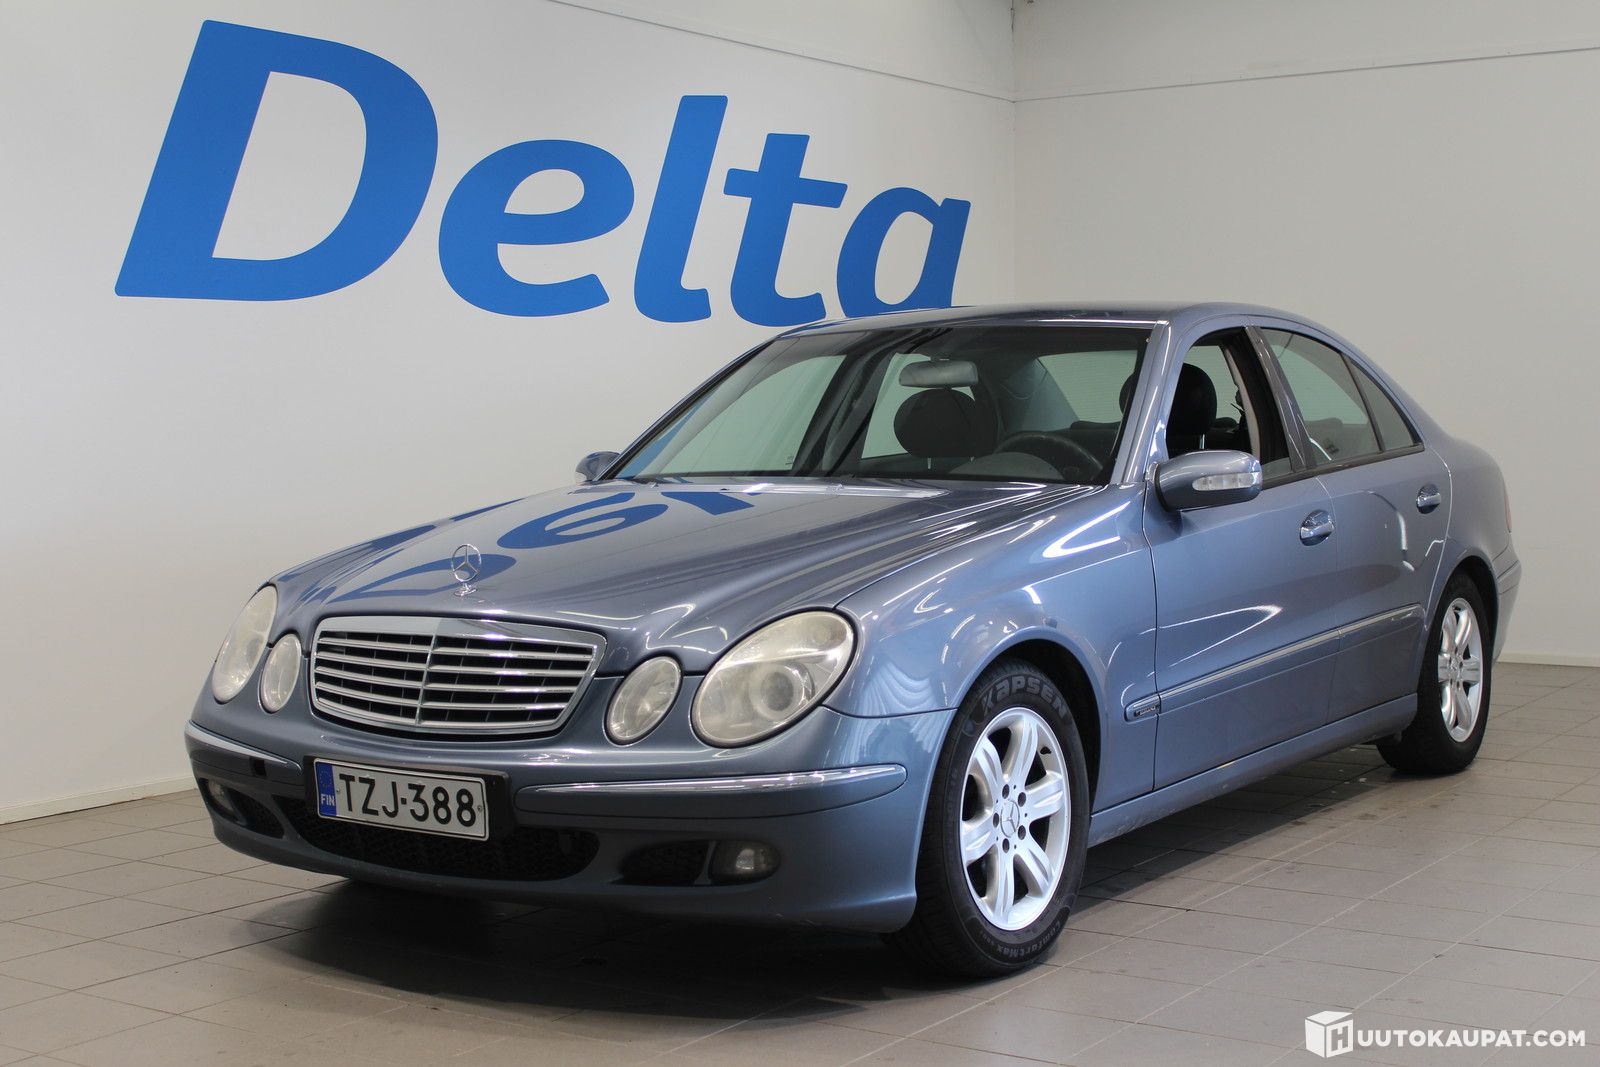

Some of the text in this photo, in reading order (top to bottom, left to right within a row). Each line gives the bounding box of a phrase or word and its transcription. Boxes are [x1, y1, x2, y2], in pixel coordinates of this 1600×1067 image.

[115, 20, 970, 327] Delta
[320, 793, 336, 807] FIN
[339, 773, 477, 828] TZJ-388
